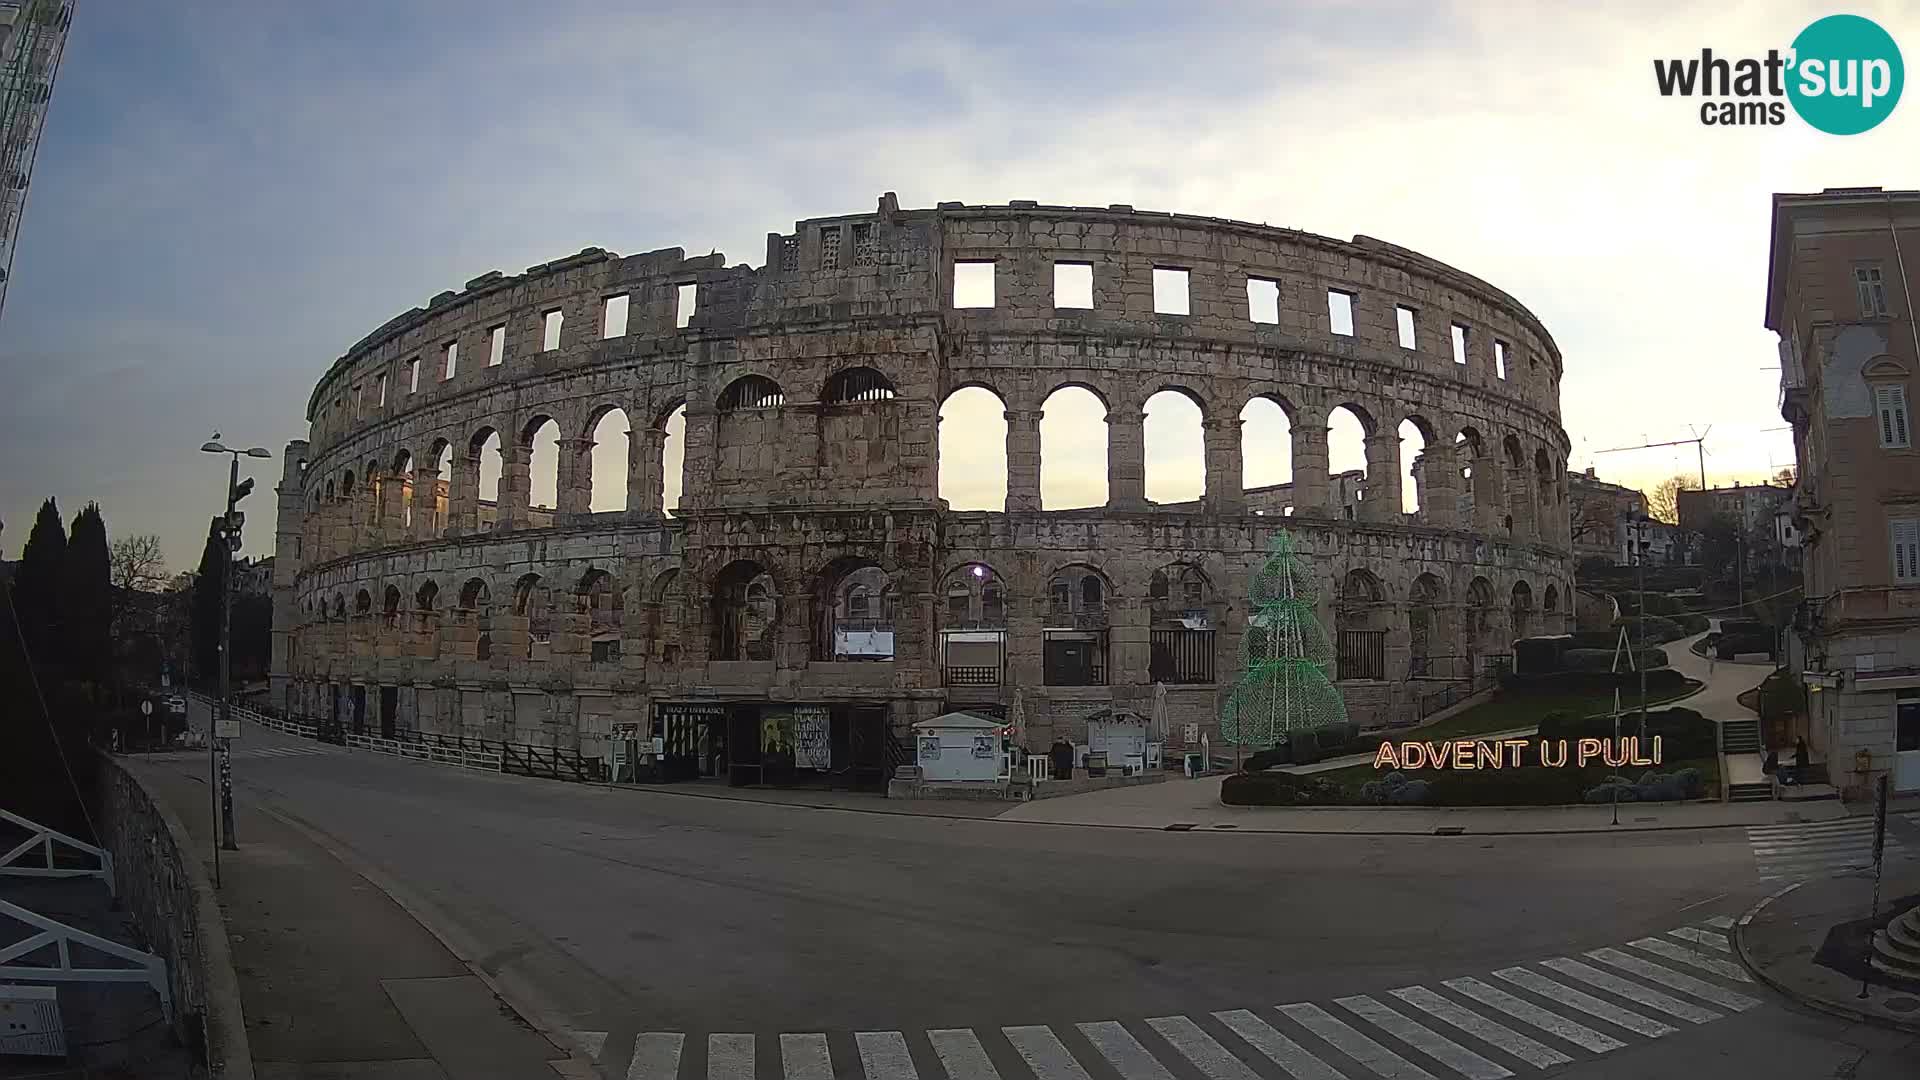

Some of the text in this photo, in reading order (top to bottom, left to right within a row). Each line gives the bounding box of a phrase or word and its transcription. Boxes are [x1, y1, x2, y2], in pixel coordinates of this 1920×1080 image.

[1373, 735, 1662, 770] ADVENT U PULI
